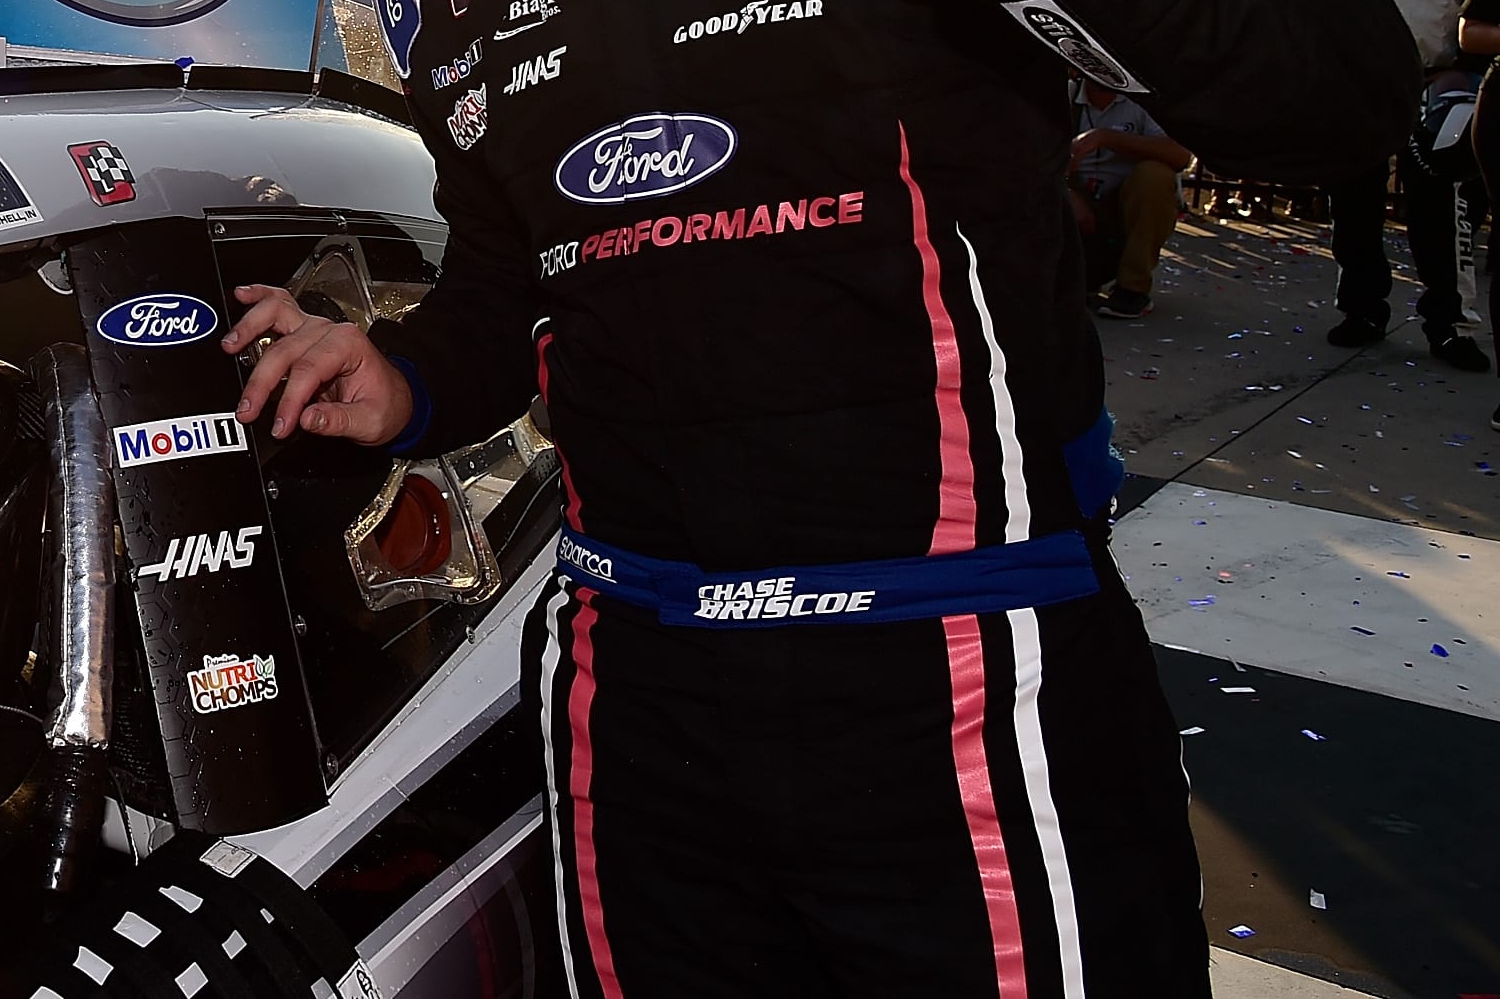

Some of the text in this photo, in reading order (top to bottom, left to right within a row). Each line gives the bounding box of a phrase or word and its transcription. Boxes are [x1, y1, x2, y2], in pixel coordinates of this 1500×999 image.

[673, 0, 824, 44] GOODYEAR
[503, 45, 567, 95] HAAS
[588, 126, 695, 193] Ford
[540, 191, 864, 280] FORD PERFORMANCE
[125, 301, 199, 339] Ford
[119, 420, 211, 462] Mobil
[138, 526, 263, 582] HAAS
[559, 536, 613, 578] sparco
[694, 590, 876, 620] BRISCOE
[698, 577, 796, 601] CHASE
[190, 662, 259, 696] NUTRI
[196, 677, 278, 711] CHOMPS
